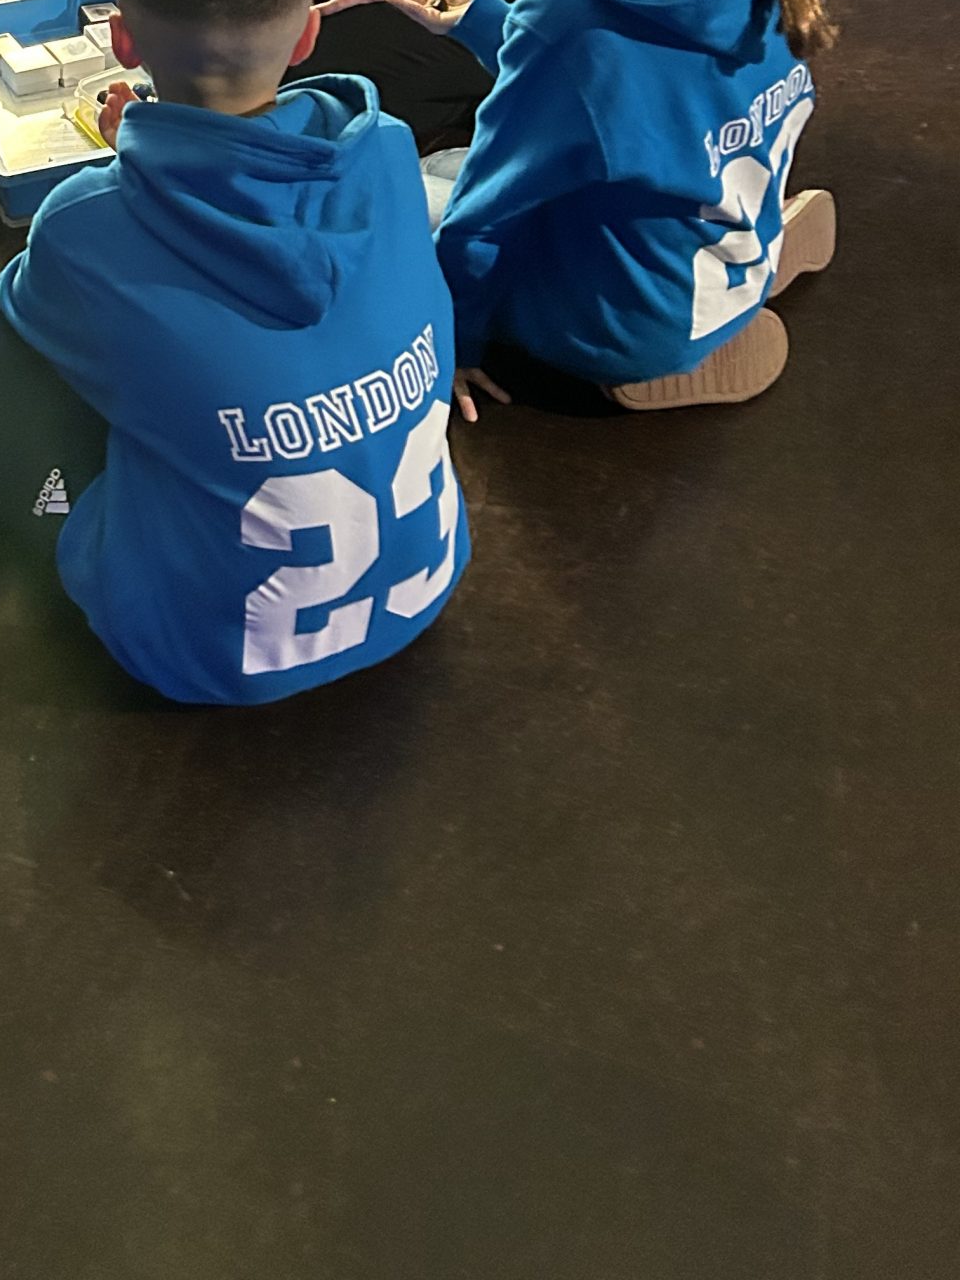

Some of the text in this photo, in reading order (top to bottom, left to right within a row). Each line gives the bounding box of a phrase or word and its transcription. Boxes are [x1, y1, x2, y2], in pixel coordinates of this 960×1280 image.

[690, 97, 815, 342] 23
[218, 323, 440, 463] LONDON
[32, 468, 61, 517] adidas
[241, 399, 459, 676] 23
